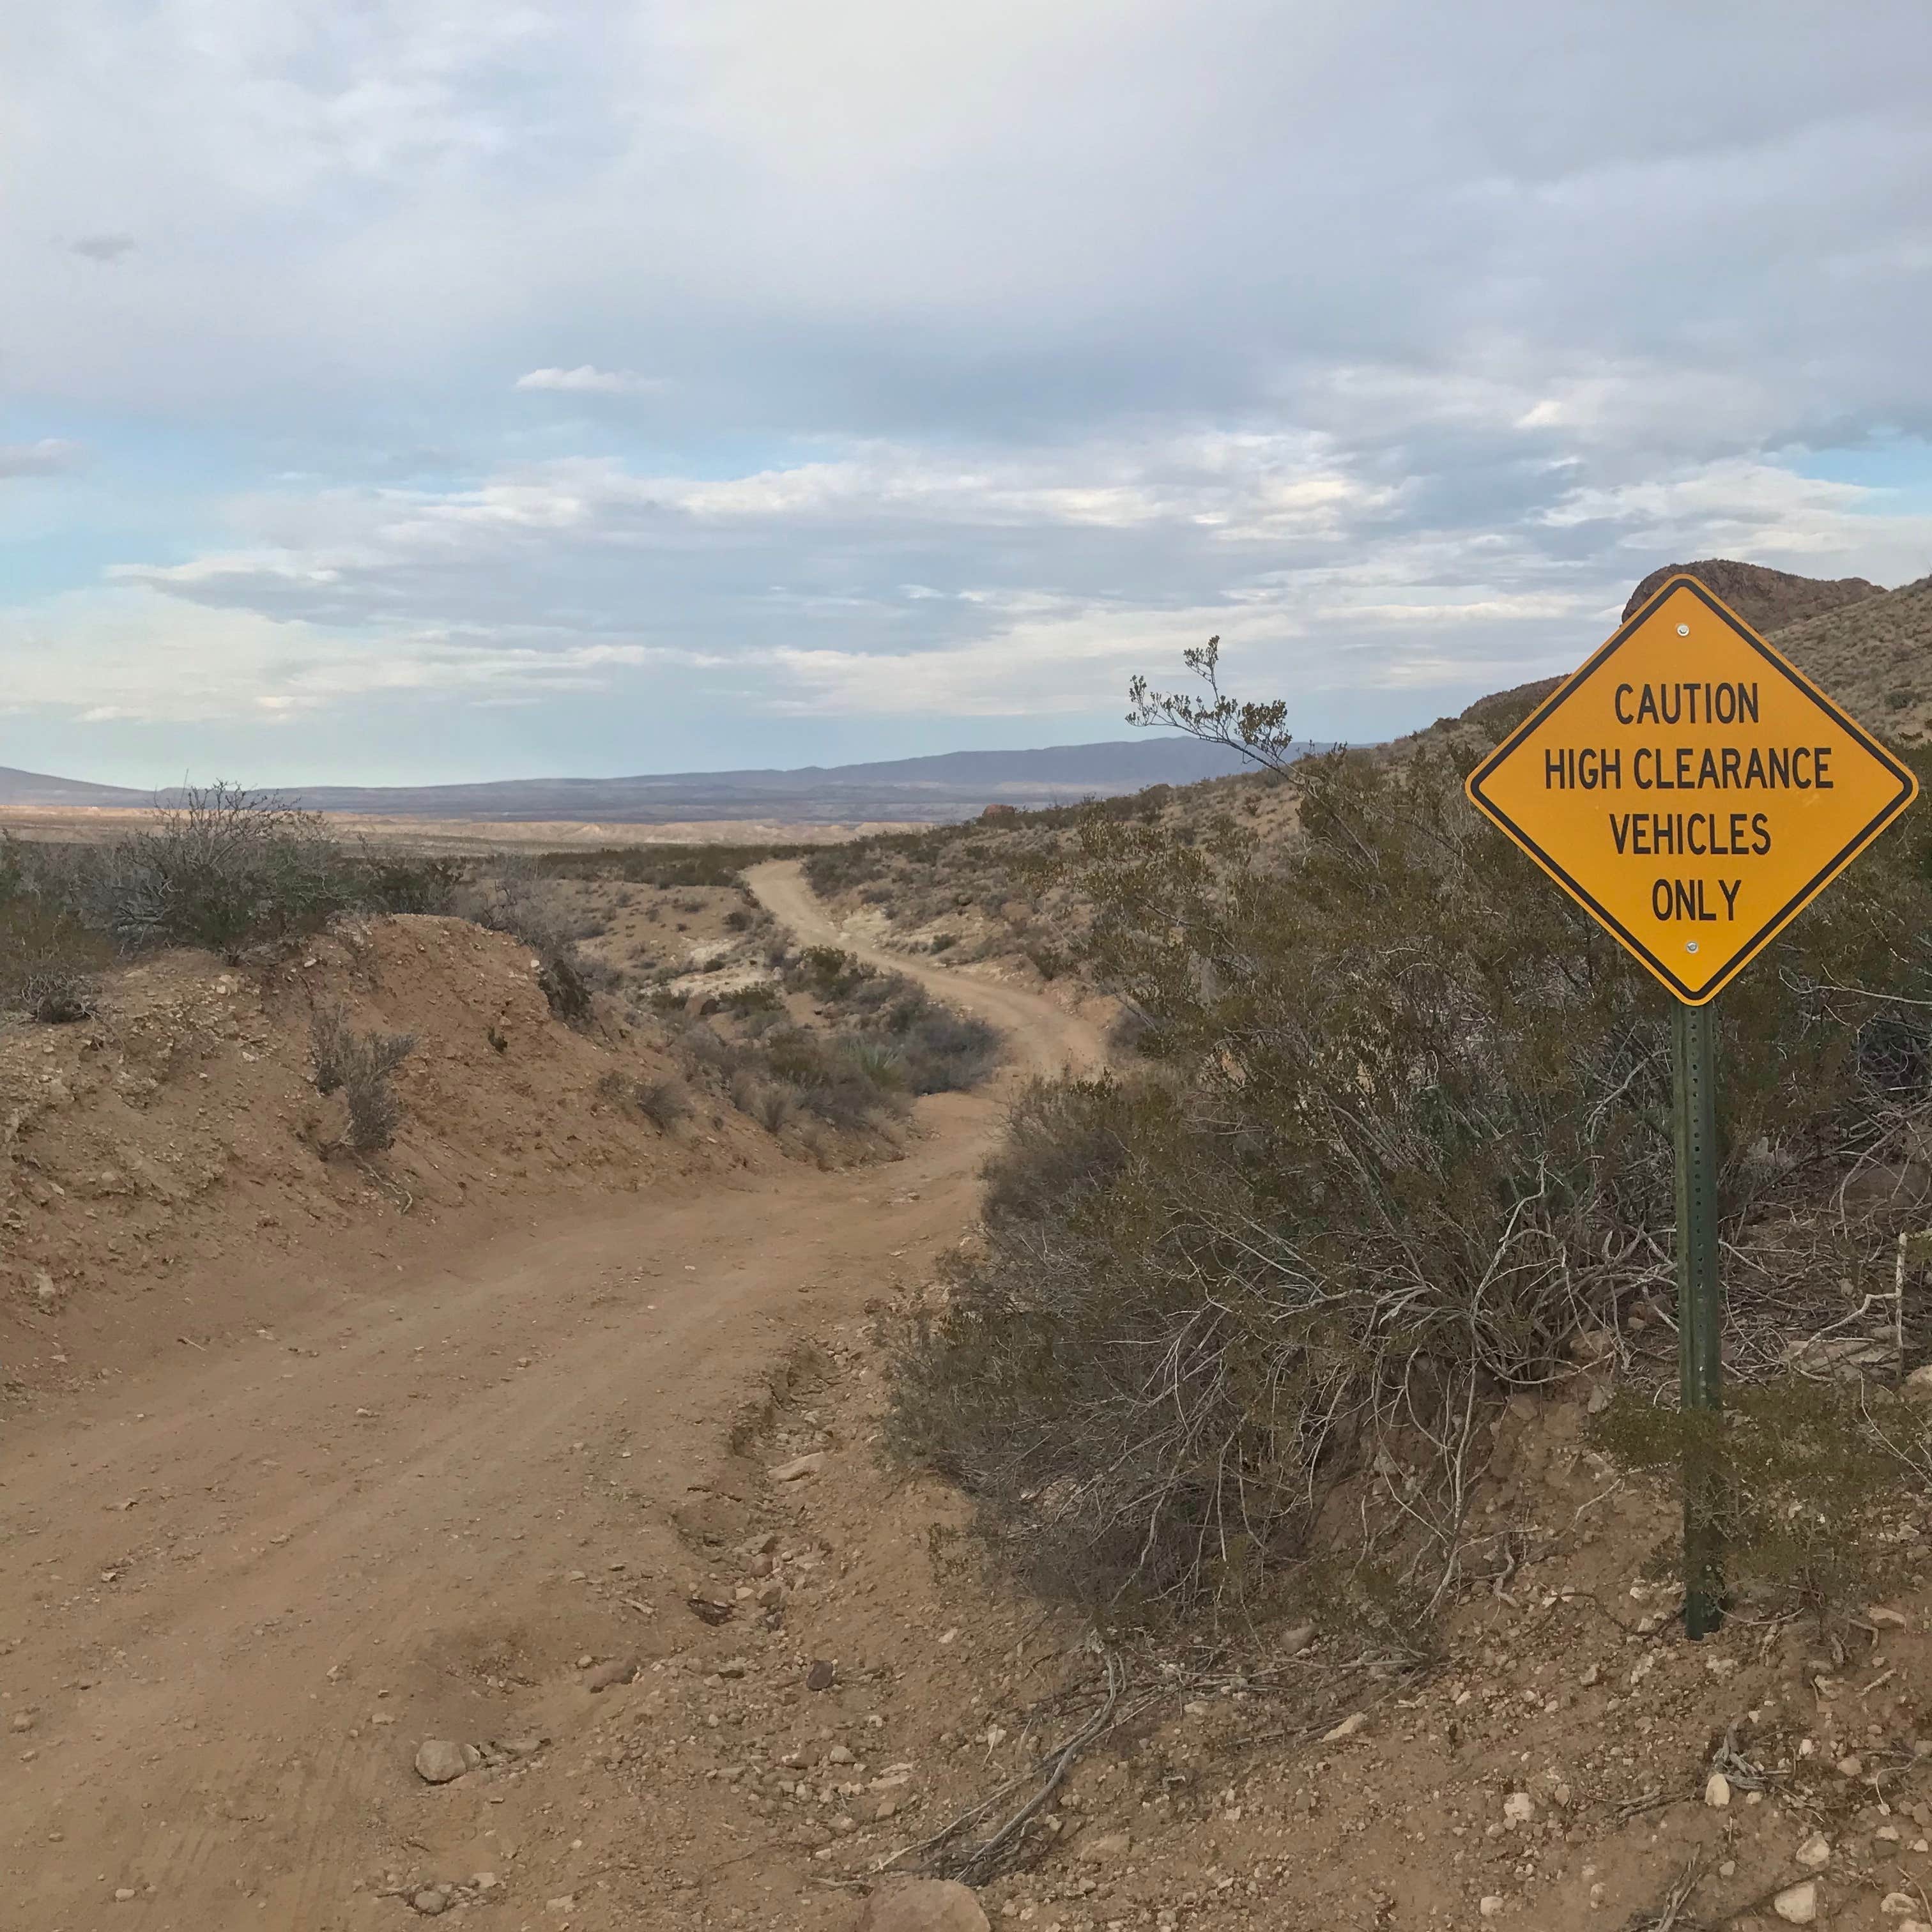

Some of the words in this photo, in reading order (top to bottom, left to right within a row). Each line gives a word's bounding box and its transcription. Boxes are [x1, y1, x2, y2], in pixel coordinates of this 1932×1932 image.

[1614, 682, 1759, 724] CAUTION
[1545, 748, 1621, 790] HIGH
[1634, 747, 1834, 790] CLEARANCE
[1609, 813, 1771, 855] VEHICLES
[1652, 878, 1742, 921] ONLY
